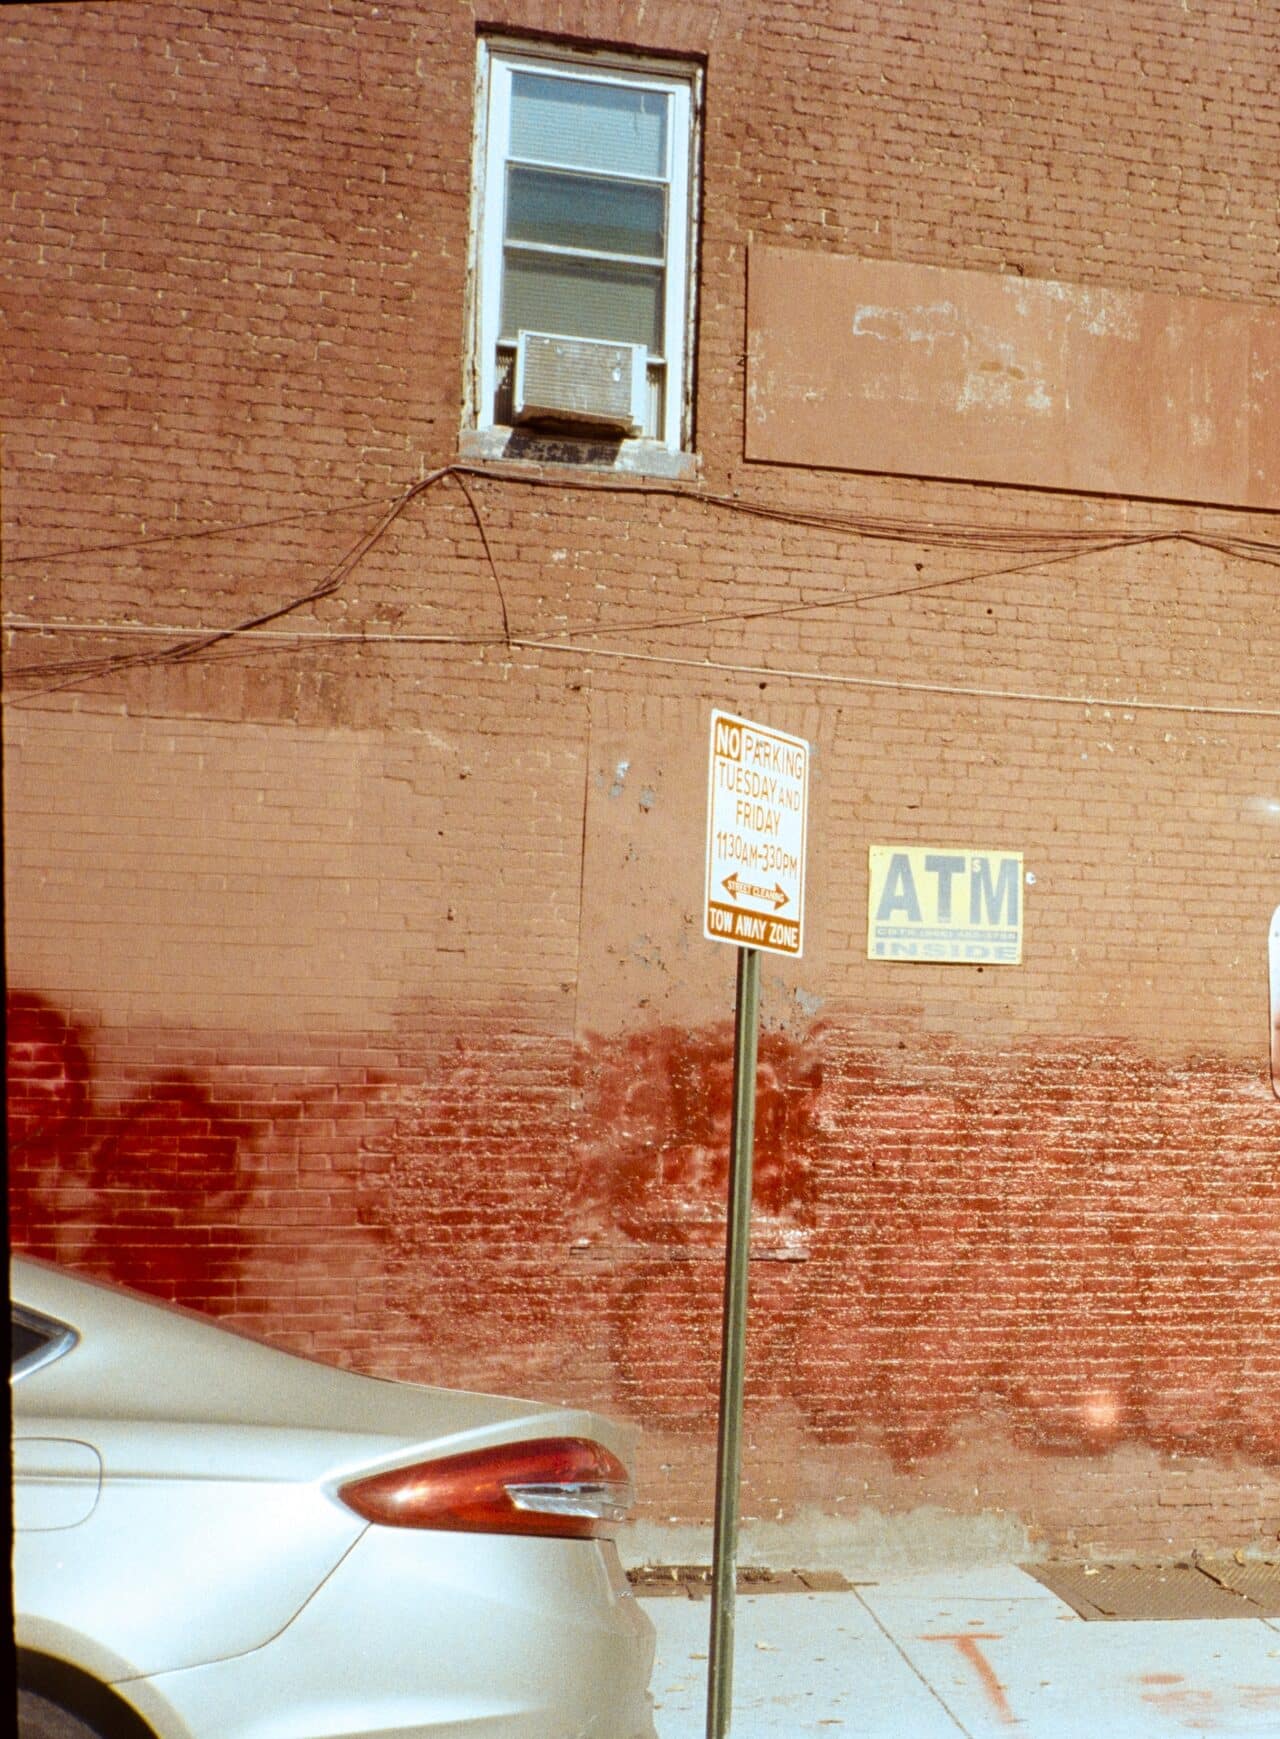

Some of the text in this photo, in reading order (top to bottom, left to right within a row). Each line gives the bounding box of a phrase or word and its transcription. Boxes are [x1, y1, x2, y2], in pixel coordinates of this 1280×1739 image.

[717, 723, 803, 780] NO PARKING
[719, 761, 800, 812] TUESDAY AND
[736, 799, 781, 837] FRIDAY
[875, 853, 1019, 926] ATM
[709, 907, 799, 948] TOW AWAY ZONE
[875, 942, 1017, 961] INSIDE
